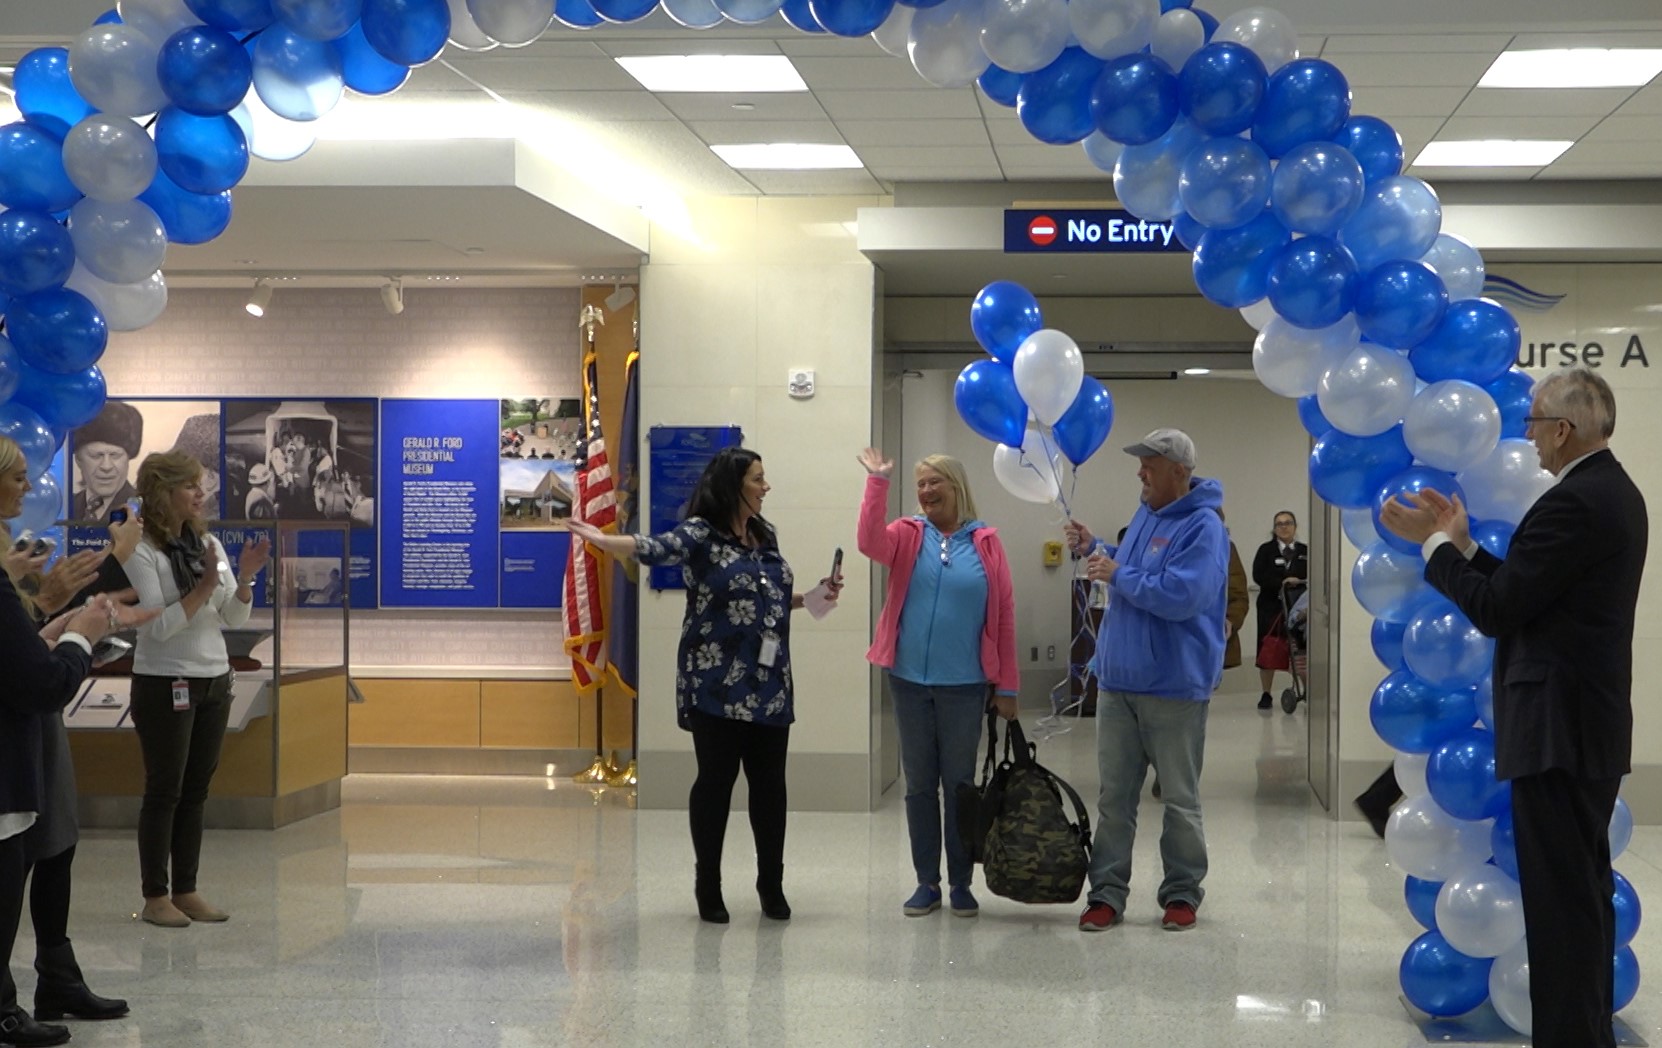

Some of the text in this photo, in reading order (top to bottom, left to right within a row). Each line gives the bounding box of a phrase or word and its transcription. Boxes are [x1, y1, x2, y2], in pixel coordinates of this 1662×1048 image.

[1067, 218, 1174, 246] No Entry
[1620, 334, 1649, 368] A
[403, 437, 432, 449] GERALD
[442, 437, 463, 450] FORD
[403, 450, 455, 462] PRESIDENTIAL
[403, 463, 434, 475] MUSEUM
